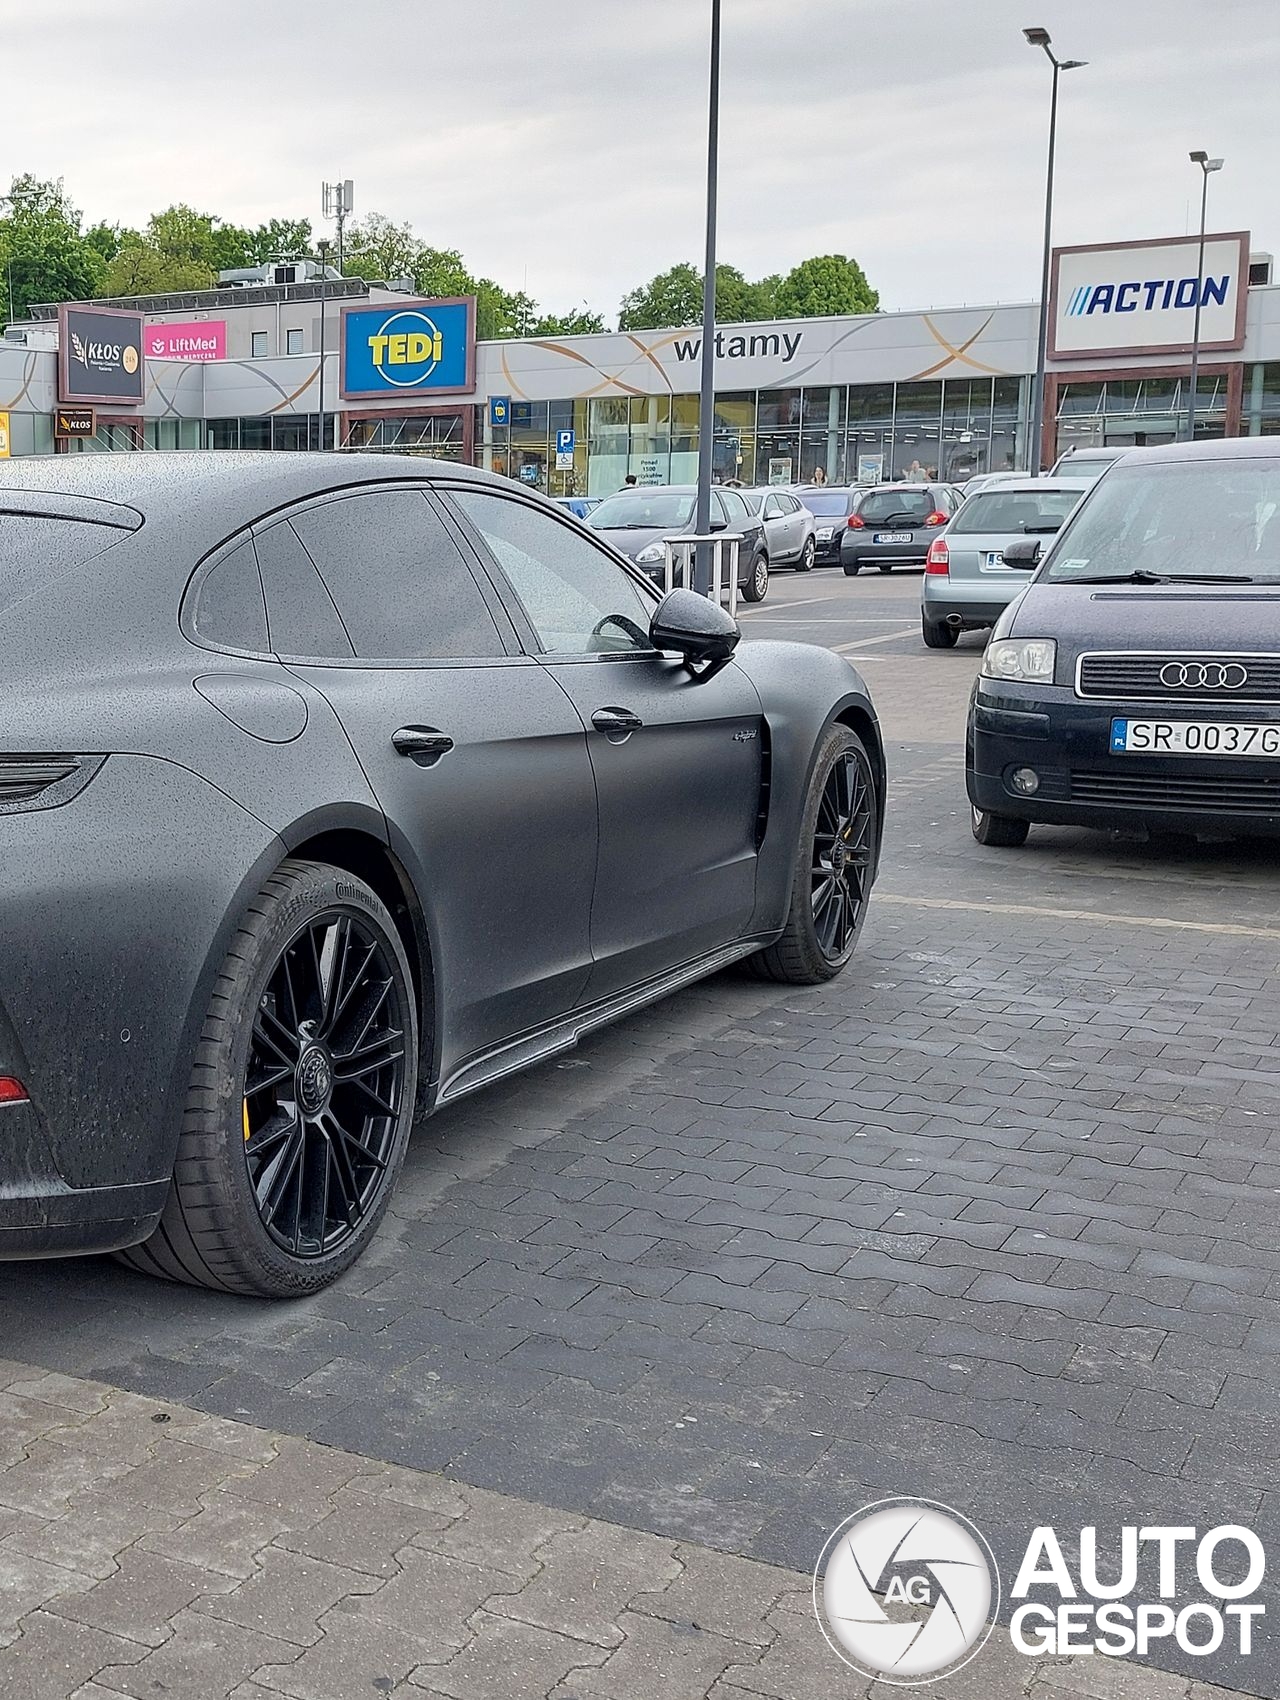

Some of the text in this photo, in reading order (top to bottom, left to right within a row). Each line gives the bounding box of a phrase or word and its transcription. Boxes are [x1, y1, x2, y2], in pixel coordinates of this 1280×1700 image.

[1086, 275, 1230, 315] ACTION
[88, 342, 121, 361] KŁOS
[169, 336, 217, 353] LiftMed
[368, 331, 443, 366] TEDi
[674, 331, 803, 363] wtamy
[560, 432, 571, 448] P
[1114, 737, 1125, 746] PL
[1131, 724, 1280, 753] SR 0037G
[335, 880, 379, 914] Continental
